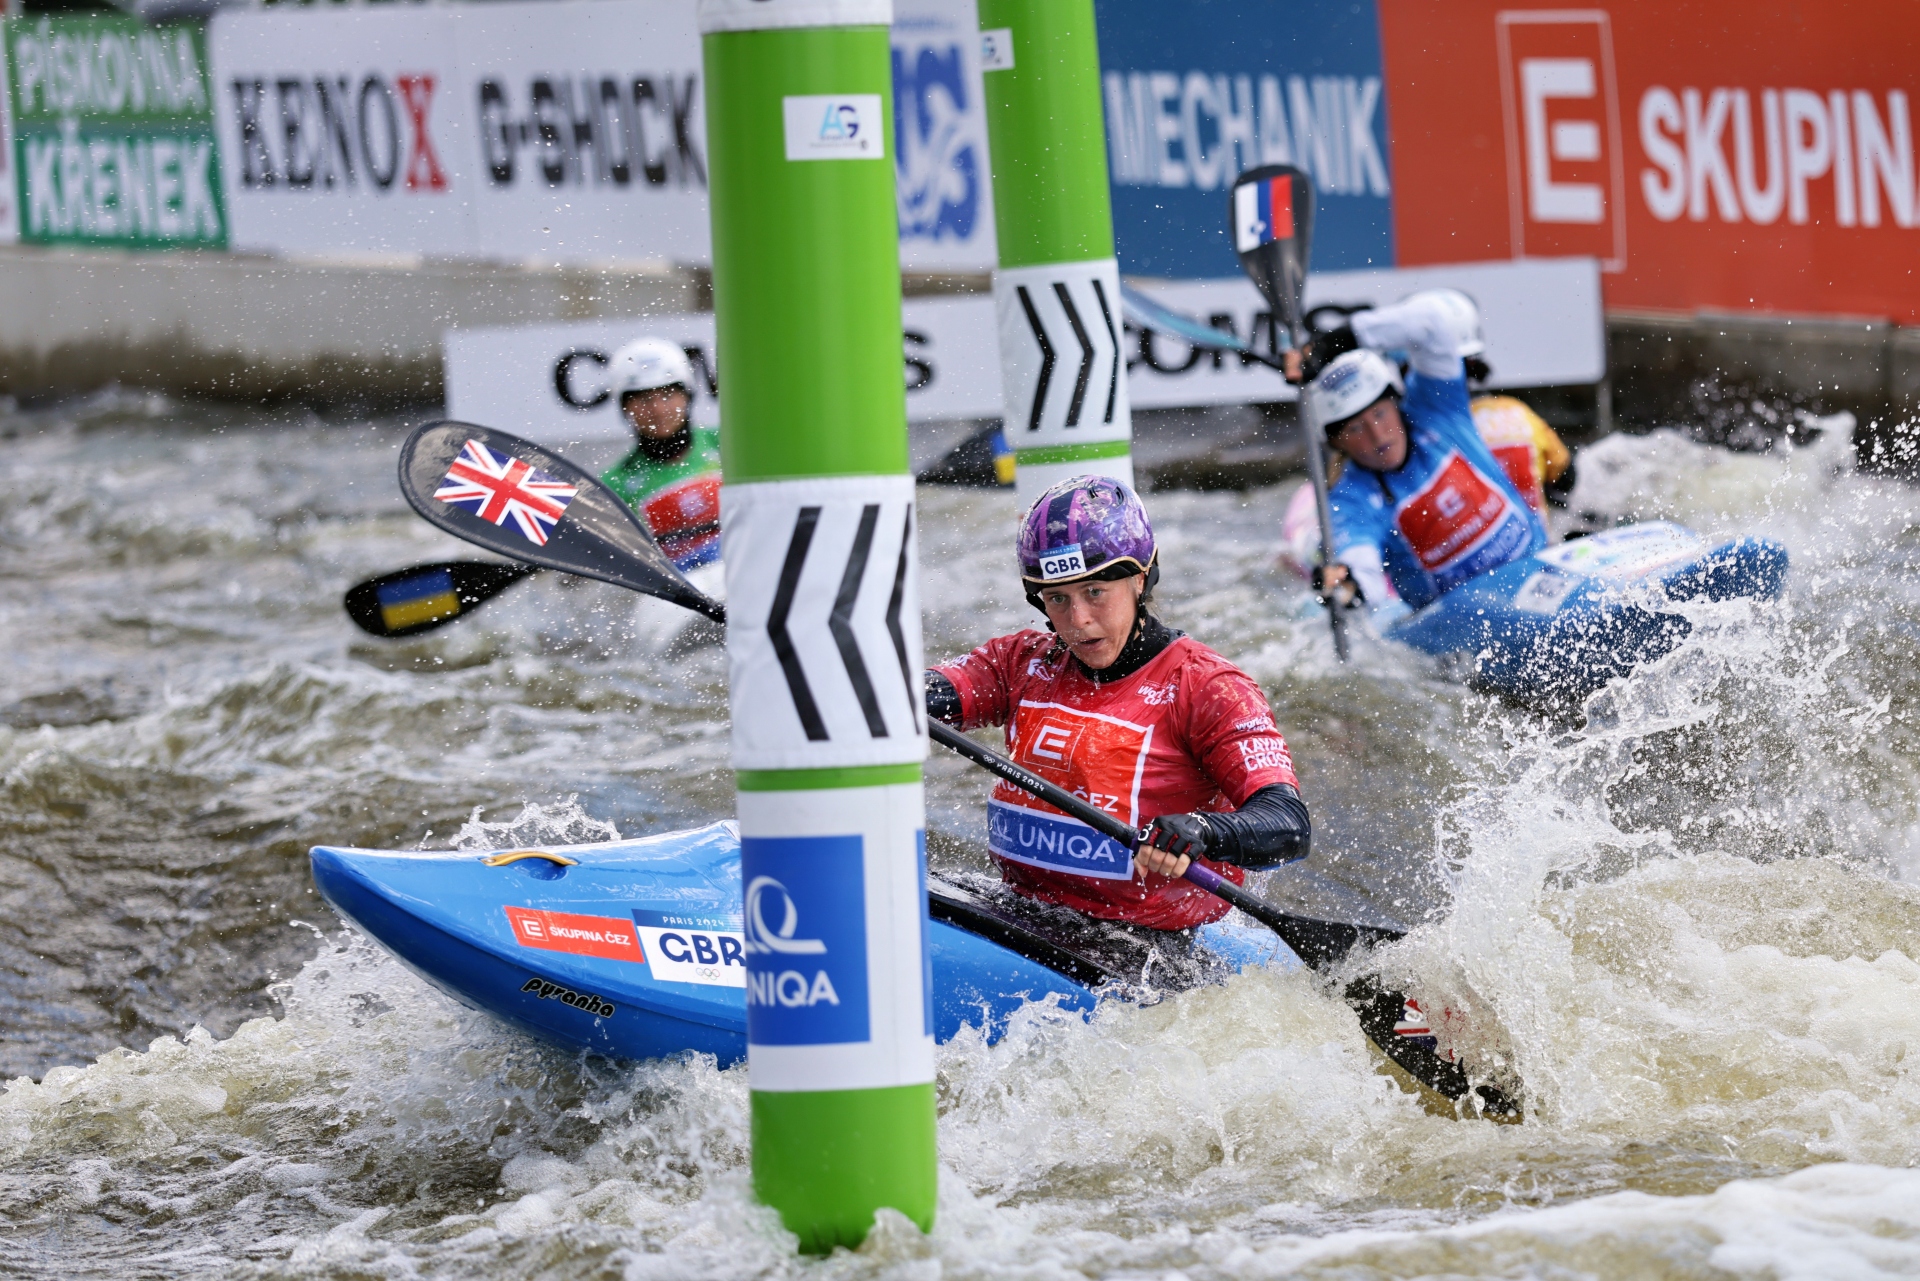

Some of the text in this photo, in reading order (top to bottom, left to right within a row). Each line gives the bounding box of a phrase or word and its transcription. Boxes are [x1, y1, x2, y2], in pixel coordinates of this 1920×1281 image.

[16, 20, 206, 114] PÍSKOVNA
[232, 75, 449, 190] KENOX
[478, 76, 708, 190] G-SHOCK
[1103, 70, 1391, 197] MECHANIK
[1638, 84, 1920, 229] SKUPIN
[27, 117, 220, 238] KŘENEK
[1044, 556, 1081, 575] GBR
[1238, 737, 1288, 756] KAYAK
[1244, 751, 1292, 772] CROSS
[996, 762, 1021, 779] PARIS
[1021, 775, 1045, 792] 2024
[1019, 823, 1116, 863] UNIQA
[549, 926, 604, 943] SKUPINA
[605, 930, 631, 945] ČEZ
[662, 916, 724, 927] PARIS 2024
[658, 932, 746, 967] GBR
[520, 977, 615, 1018] pyranha
